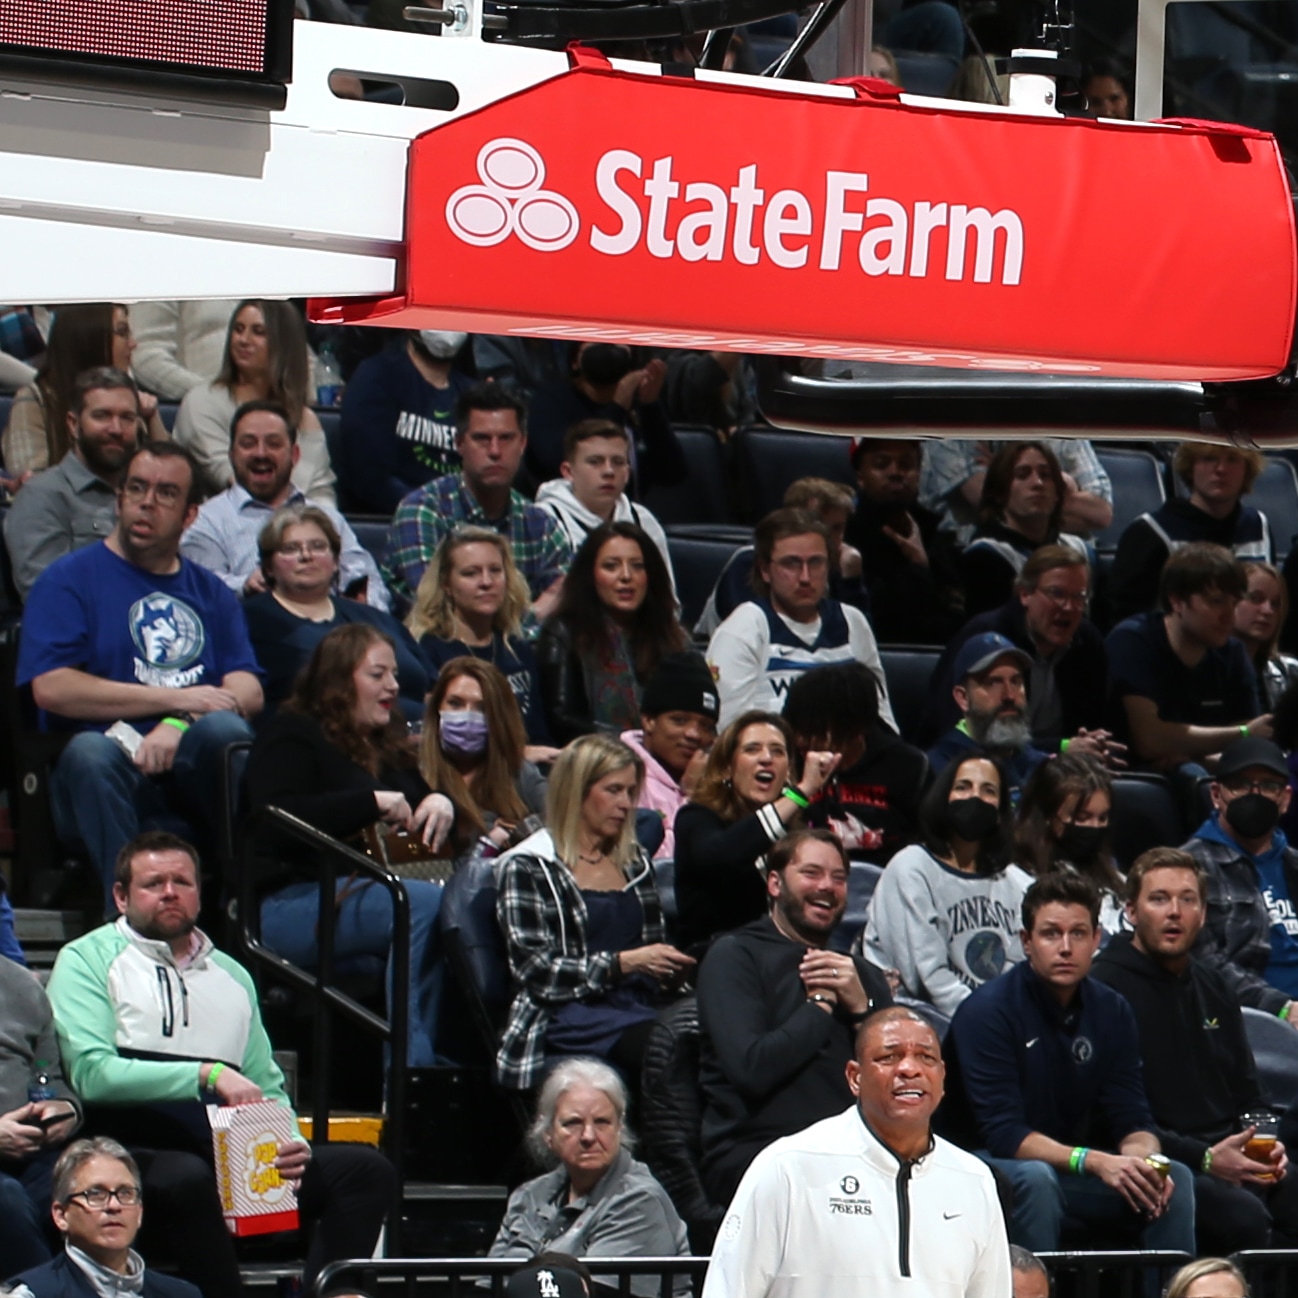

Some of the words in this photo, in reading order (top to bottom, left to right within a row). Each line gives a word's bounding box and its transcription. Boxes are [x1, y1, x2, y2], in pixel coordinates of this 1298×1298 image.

[396, 411, 458, 451] MINNE
[845, 1178, 857, 1193] 6
[829, 1203, 872, 1216] 76ERS
